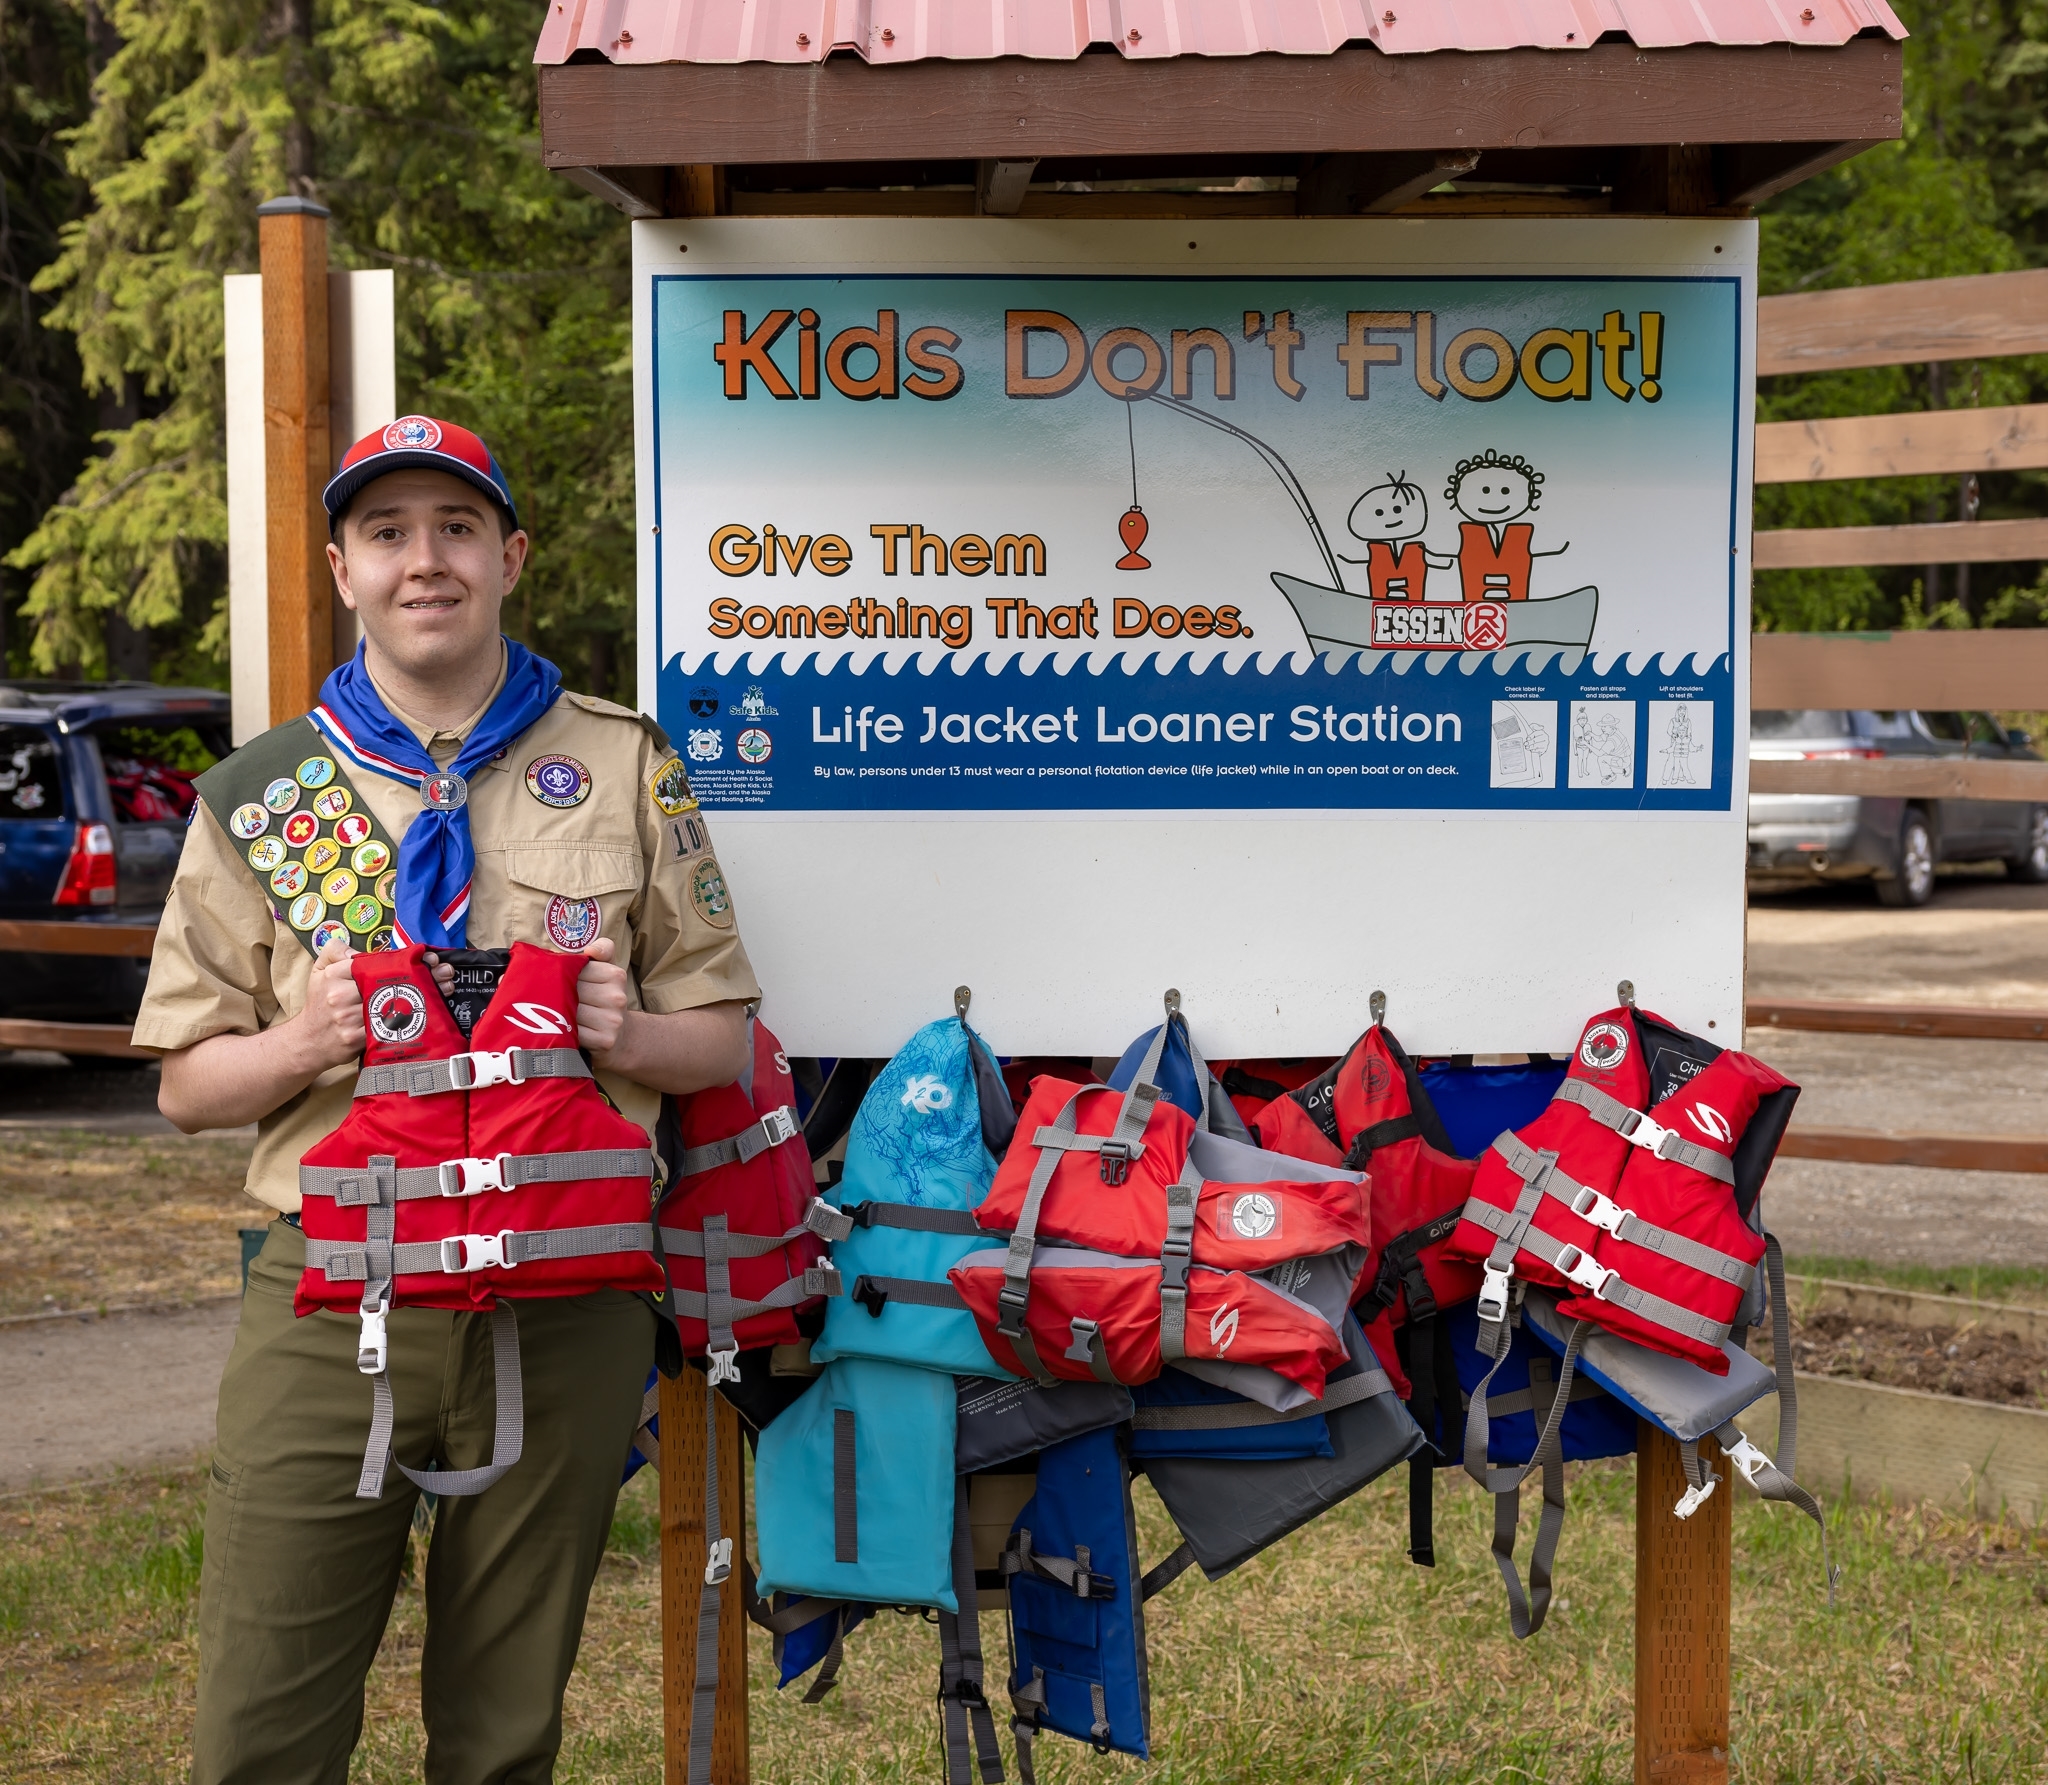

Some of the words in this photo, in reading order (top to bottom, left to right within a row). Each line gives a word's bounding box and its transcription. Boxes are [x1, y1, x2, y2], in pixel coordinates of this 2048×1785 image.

[714, 308, 965, 401] Kids
[1004, 308, 1304, 402] Don't
[1338, 309, 1666, 404] Float!
[708, 523, 853, 578] Give
[869, 523, 1047, 577] Them
[708, 596, 973, 650] Something
[986, 596, 1099, 640] That
[1112, 596, 1254, 640] Does.
[1374, 606, 1465, 644] ESSEN
[1538, 685, 1546, 694] for
[1598, 692, 1620, 700] zippers.
[1608, 686, 1627, 694] straps
[729, 705, 753, 716] Safe
[754, 705, 775, 716] Kids
[812, 705, 905, 752] Life
[919, 705, 1079, 744] Jacket
[1096, 705, 1275, 743] Loaner
[1288, 704, 1463, 742] Station
[687, 775, 721, 783] Department
[721, 775, 729, 783] of
[726, 769, 735, 777] by
[813, 766, 830, 779] By
[834, 765, 856, 777] law,
[859, 767, 907, 778] persons
[910, 765, 947, 776] under
[948, 765, 961, 776] 13
[964, 766, 993, 776] must
[994, 767, 1023, 776] wear
[1026, 767, 1035, 776] a
[1038, 765, 1091, 778] personal
[1094, 765, 1145, 778] flotation
[1147, 765, 1188, 776] device
[1191, 764, 1214, 777] (life
[1215, 764, 1257, 777] jacket)
[1259, 765, 1290, 775] while
[1293, 764, 1305, 775] in
[1307, 766, 1324, 775] an
[1326, 766, 1358, 777] open
[1361, 764, 1390, 775] boat
[1392, 766, 1405, 775] or
[1407, 766, 1423, 775] on
[1426, 765, 1459, 775] deck.
[690, 782, 712, 790] ervices,
[732, 782, 747, 790] Safe
[714, 796, 721, 804] of
[721, 796, 744, 804] Boating
[744, 796, 766, 804] Safety.
[331, 876, 349, 894] SALE
[551, 926, 571, 947] SCOUTS
[571, 940, 580, 948] OF
[580, 919, 597, 946] AMERICA
[452, 969, 494, 984] CHILD
[373, 991, 392, 1012] Alaska
[398, 988, 420, 1008] Boating
[375, 1020, 394, 1038] Safety
[402, 1013, 421, 1036] Program
[1587, 1027, 1606, 1041] Alaska
[1667, 1081, 1679, 1091] 70
[1257, 1197, 1272, 1212] Alaska
[958, 1402, 977, 1414] LEASE
[996, 1387, 1015, 1397] ATTAC
[968, 1401, 995, 1415] WARNING
[1022, 1384, 1039, 1393] CLEA
[995, 1407, 1008, 1416] Made
